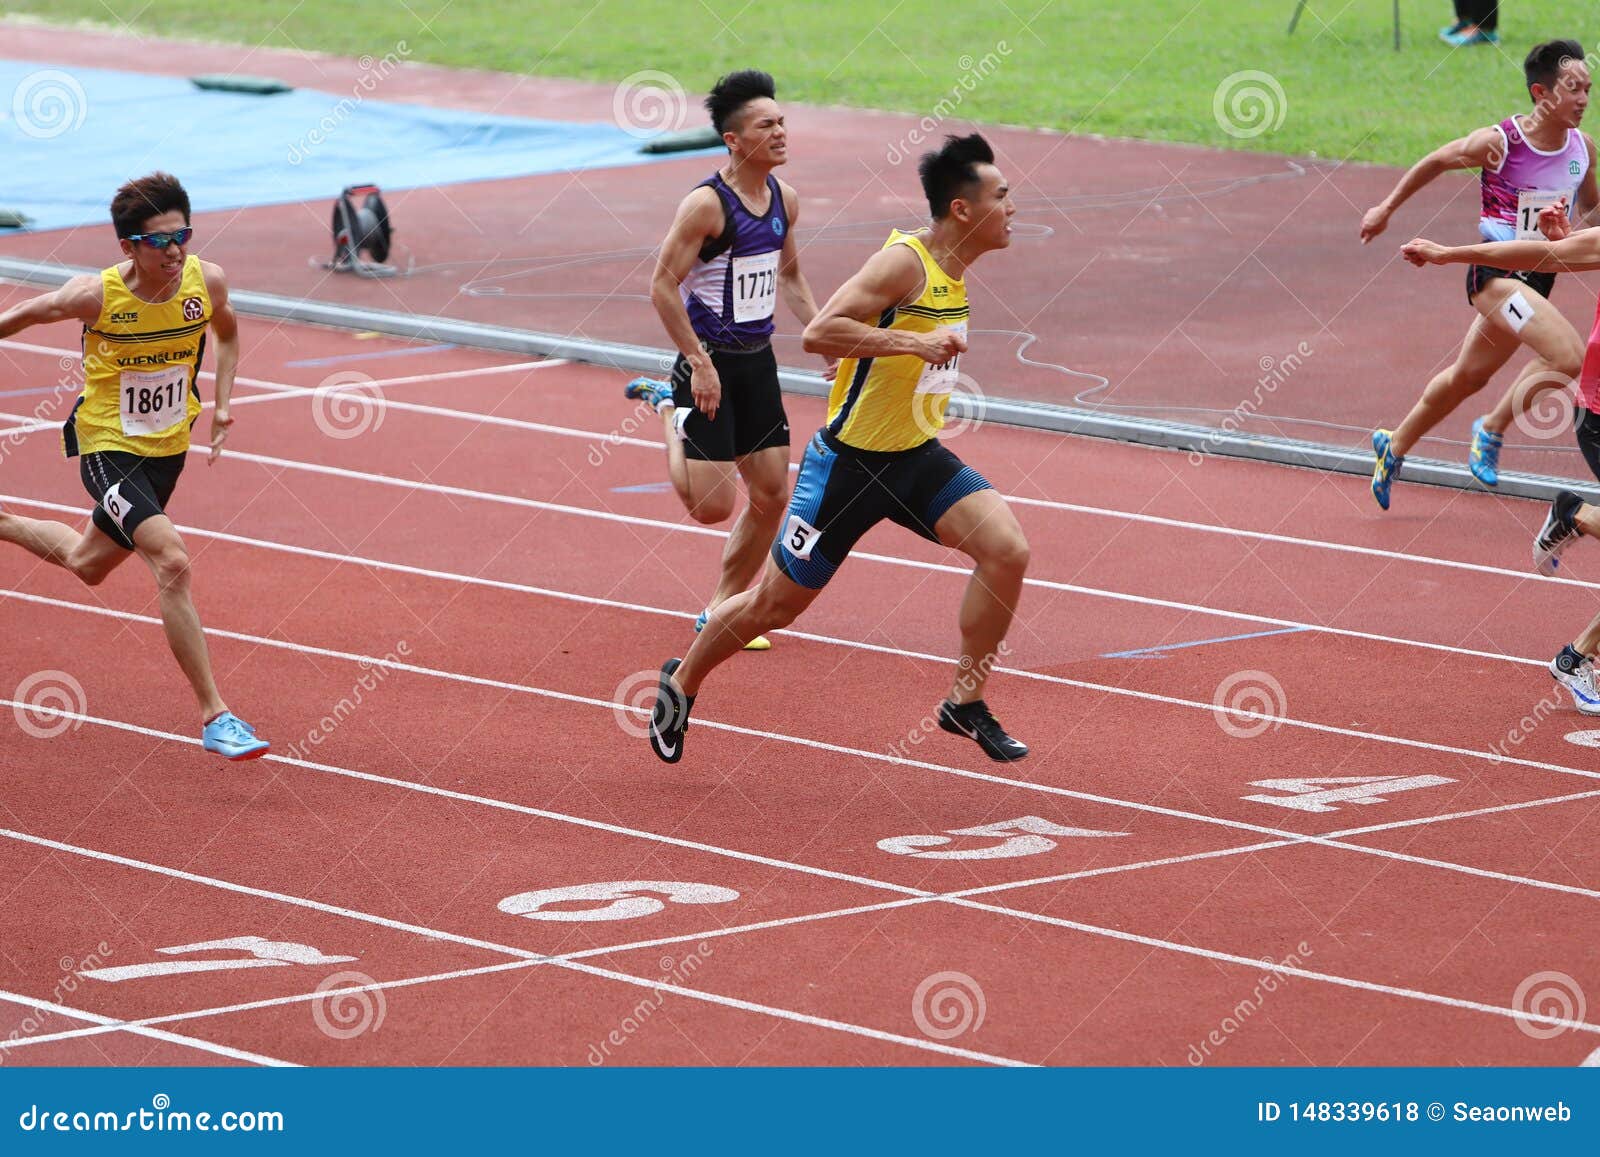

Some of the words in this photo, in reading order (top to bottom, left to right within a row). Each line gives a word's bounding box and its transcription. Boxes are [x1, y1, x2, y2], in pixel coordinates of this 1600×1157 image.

[1508, 303, 1523, 321] 1
[125, 377, 183, 414] 18611
[107, 494, 120, 517] 6
[791, 525, 809, 550] 5
[1239, 774, 1456, 813] 4
[876, 815, 1131, 861] 5
[497, 880, 740, 922] 6
[76, 936, 358, 983] 7
